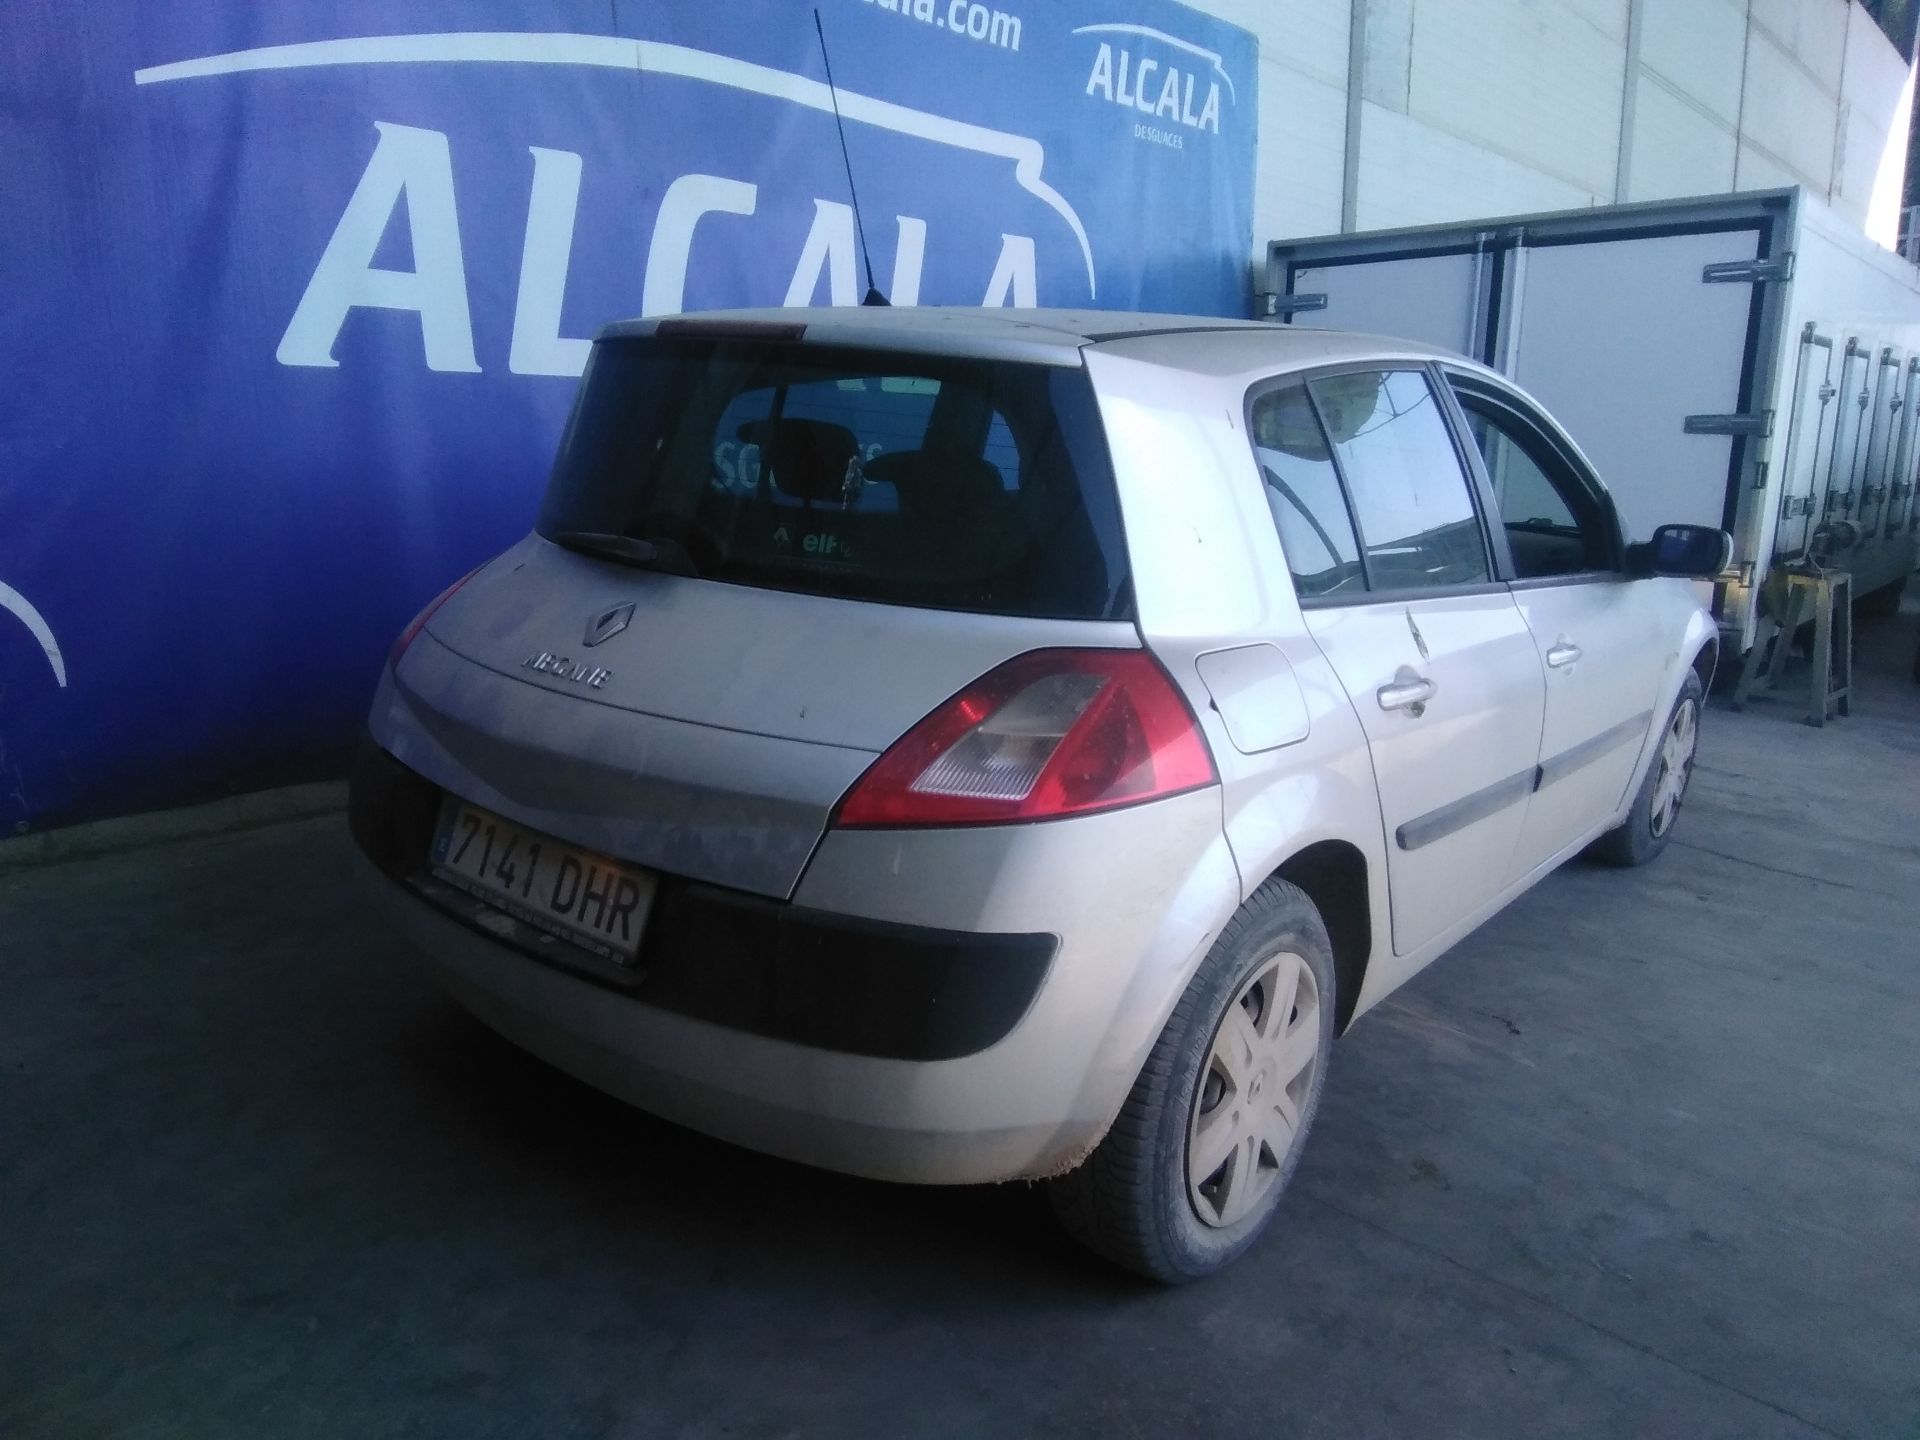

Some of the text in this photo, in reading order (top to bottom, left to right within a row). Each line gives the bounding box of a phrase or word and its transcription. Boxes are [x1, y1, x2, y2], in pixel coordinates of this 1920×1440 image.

[1086, 41, 1220, 135] ALCALA
[1134, 123, 1184, 150] DESGUACES
[803, 533, 838, 554] elf
[452, 812, 541, 898] 7141
[550, 854, 640, 941] DHR
